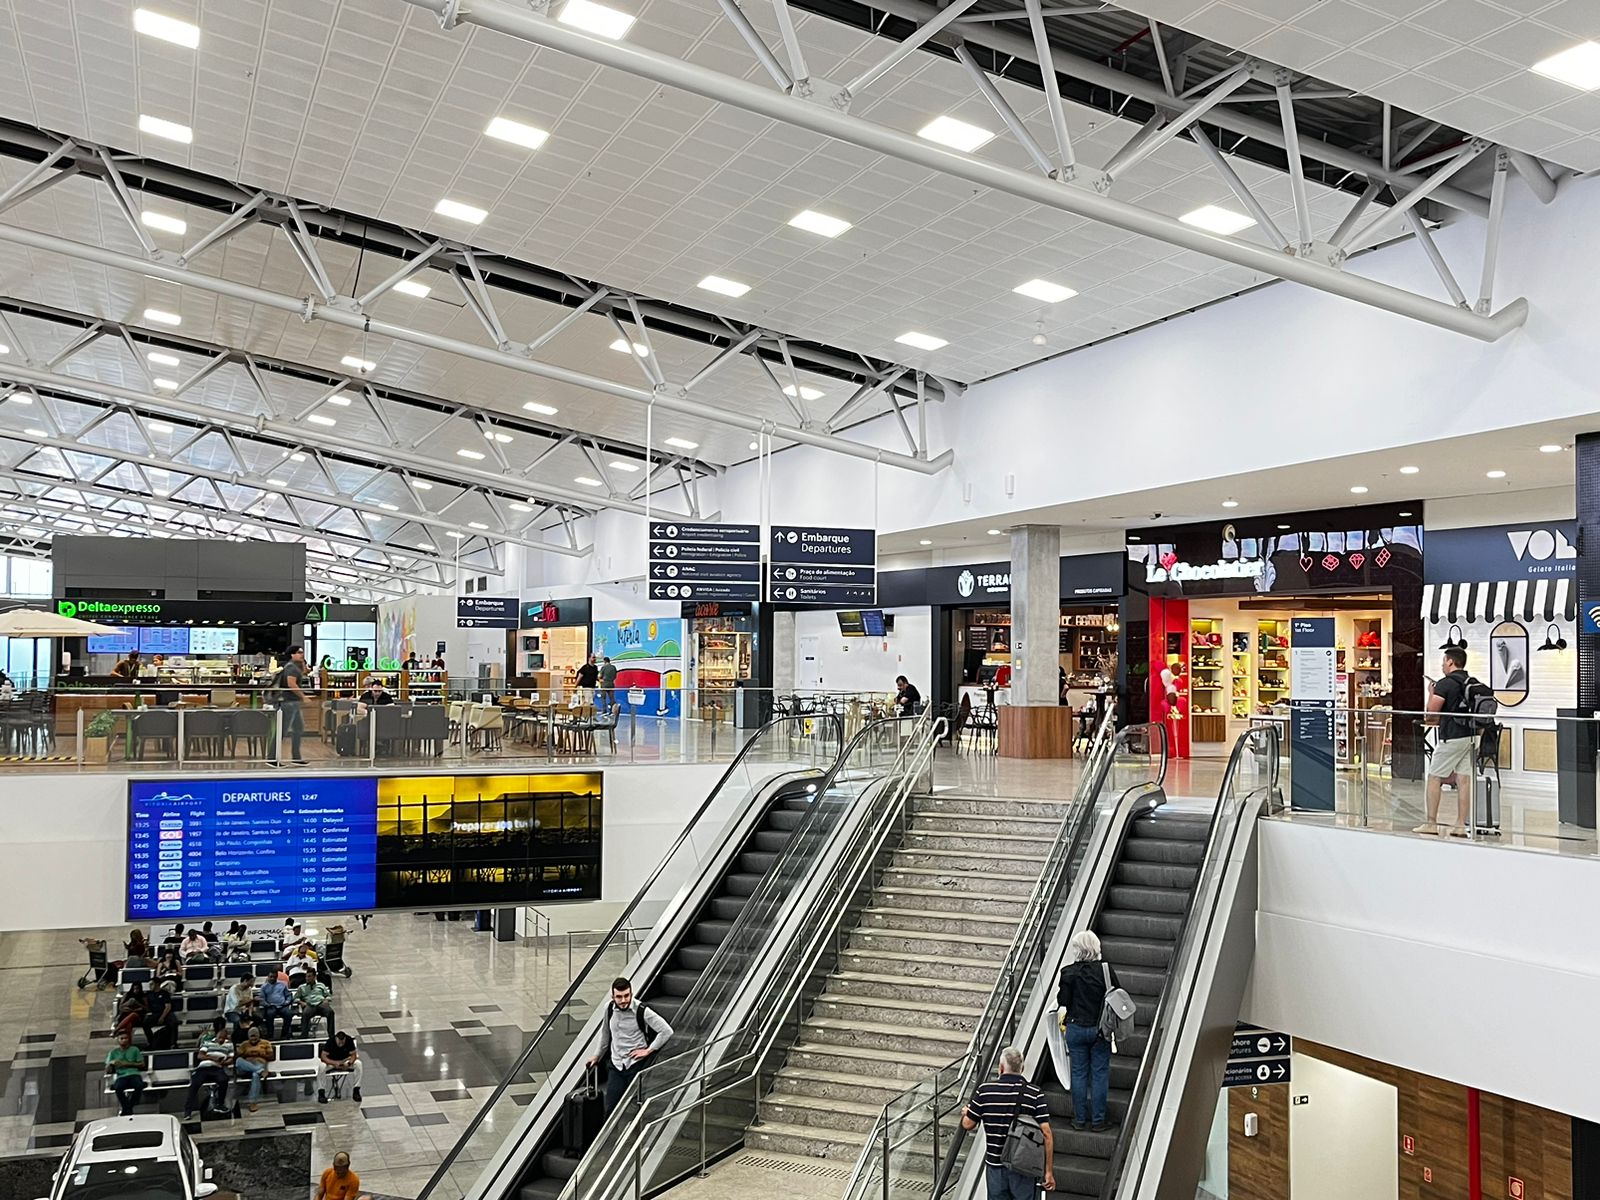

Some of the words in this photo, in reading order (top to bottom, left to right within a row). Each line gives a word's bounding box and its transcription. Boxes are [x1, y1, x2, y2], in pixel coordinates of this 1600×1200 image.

[801, 532, 850, 543] Embarque
[801, 543, 852, 554] Departures
[1146, 564, 1168, 582] Le
[1171, 558, 1264, 581] Chocolatier
[977, 574, 1011, 586] TERRA
[78, 602, 160, 614] Deltaexpresso
[324, 656, 358, 670] Grab
[363, 657, 373, 670] &
[380, 657, 400, 670] Go
[222, 792, 291, 803] DEPARTURES
